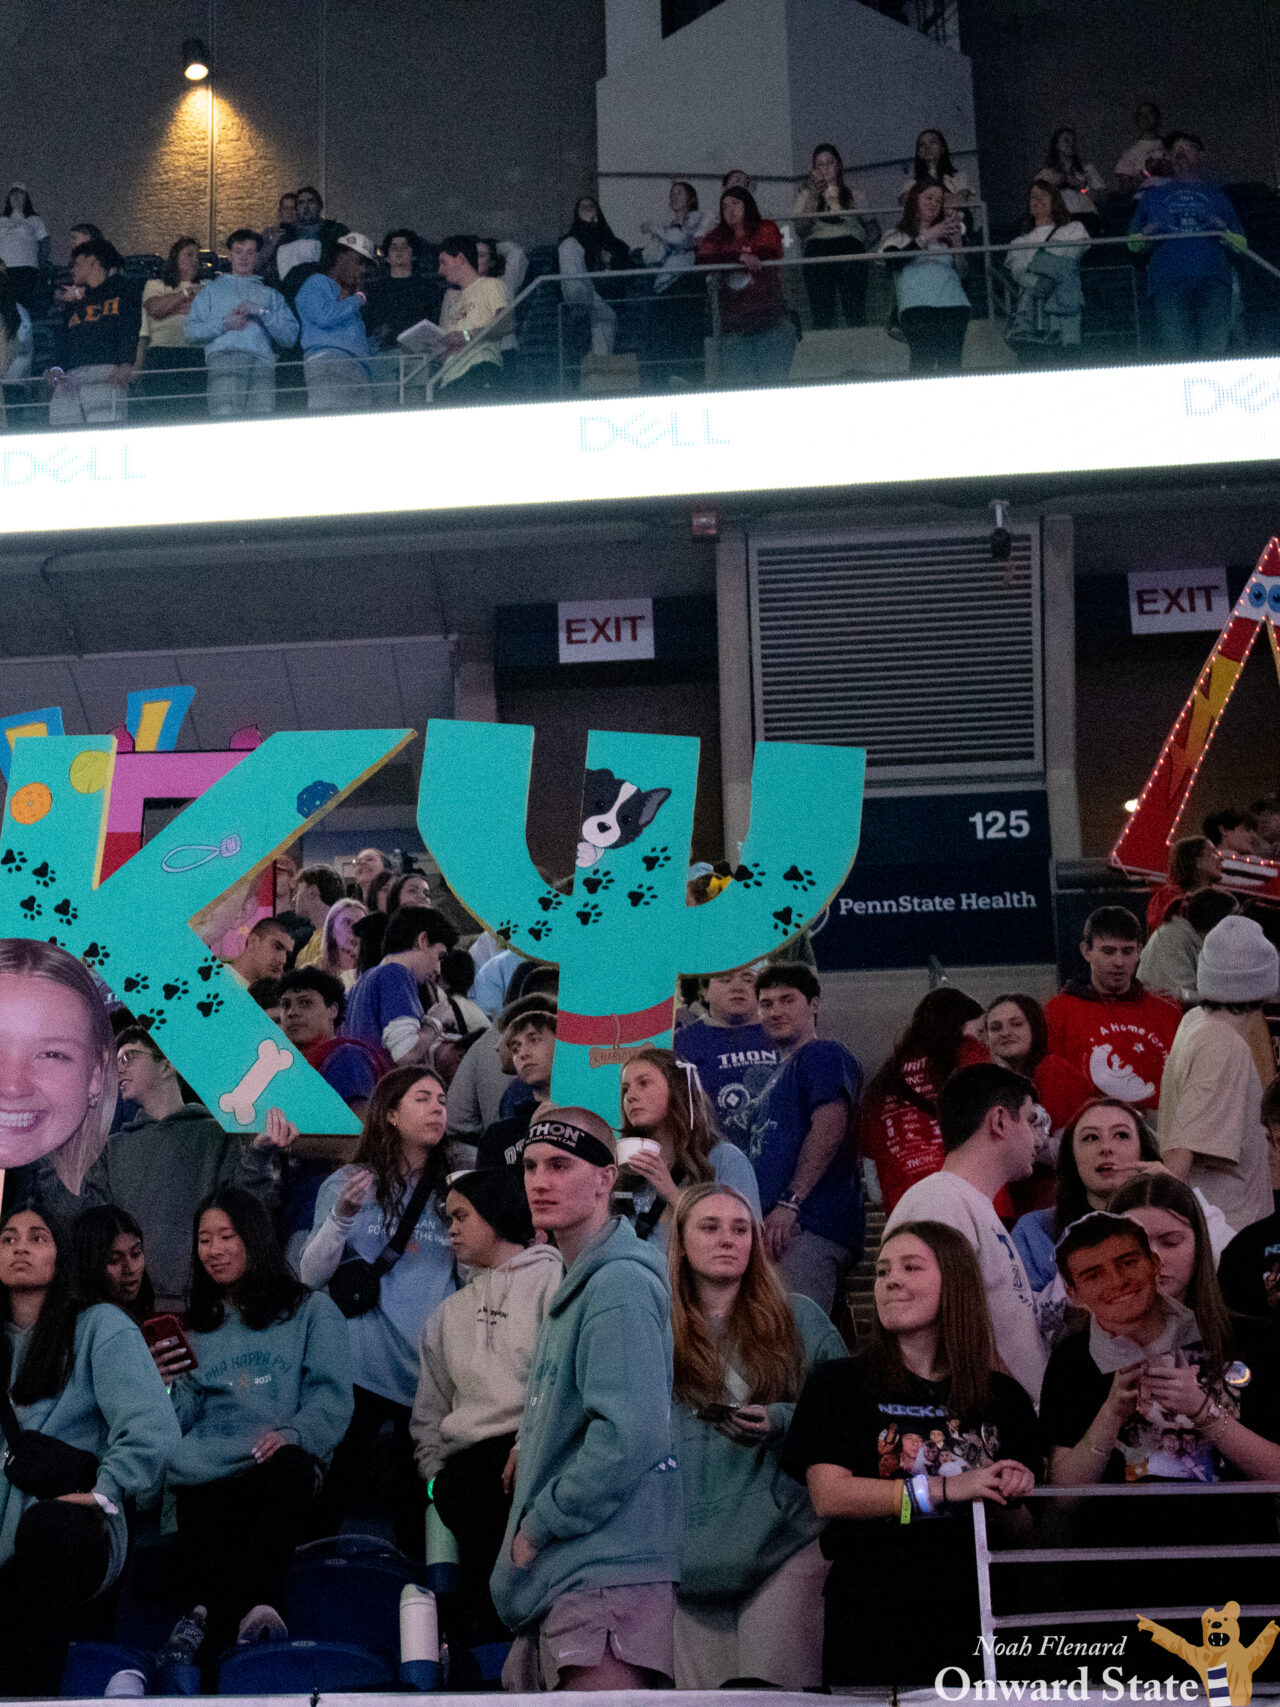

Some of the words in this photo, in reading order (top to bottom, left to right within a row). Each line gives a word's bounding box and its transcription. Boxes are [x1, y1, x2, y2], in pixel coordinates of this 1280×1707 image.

[1182, 371, 1280, 417] DE
[577, 407, 733, 453] DELL
[1, 444, 147, 488] DELL
[1136, 585, 1219, 615] EXIT
[566, 615, 645, 645] EXIT
[969, 810, 1030, 840] 125
[839, 895, 956, 915] PennState
[960, 891, 1037, 911] Health
[1100, 1026, 1109, 1036] A
[1110, 1022, 1145, 1035] Home
[717, 1050, 777, 1066] THON
[529, 1122, 580, 1143] THON
